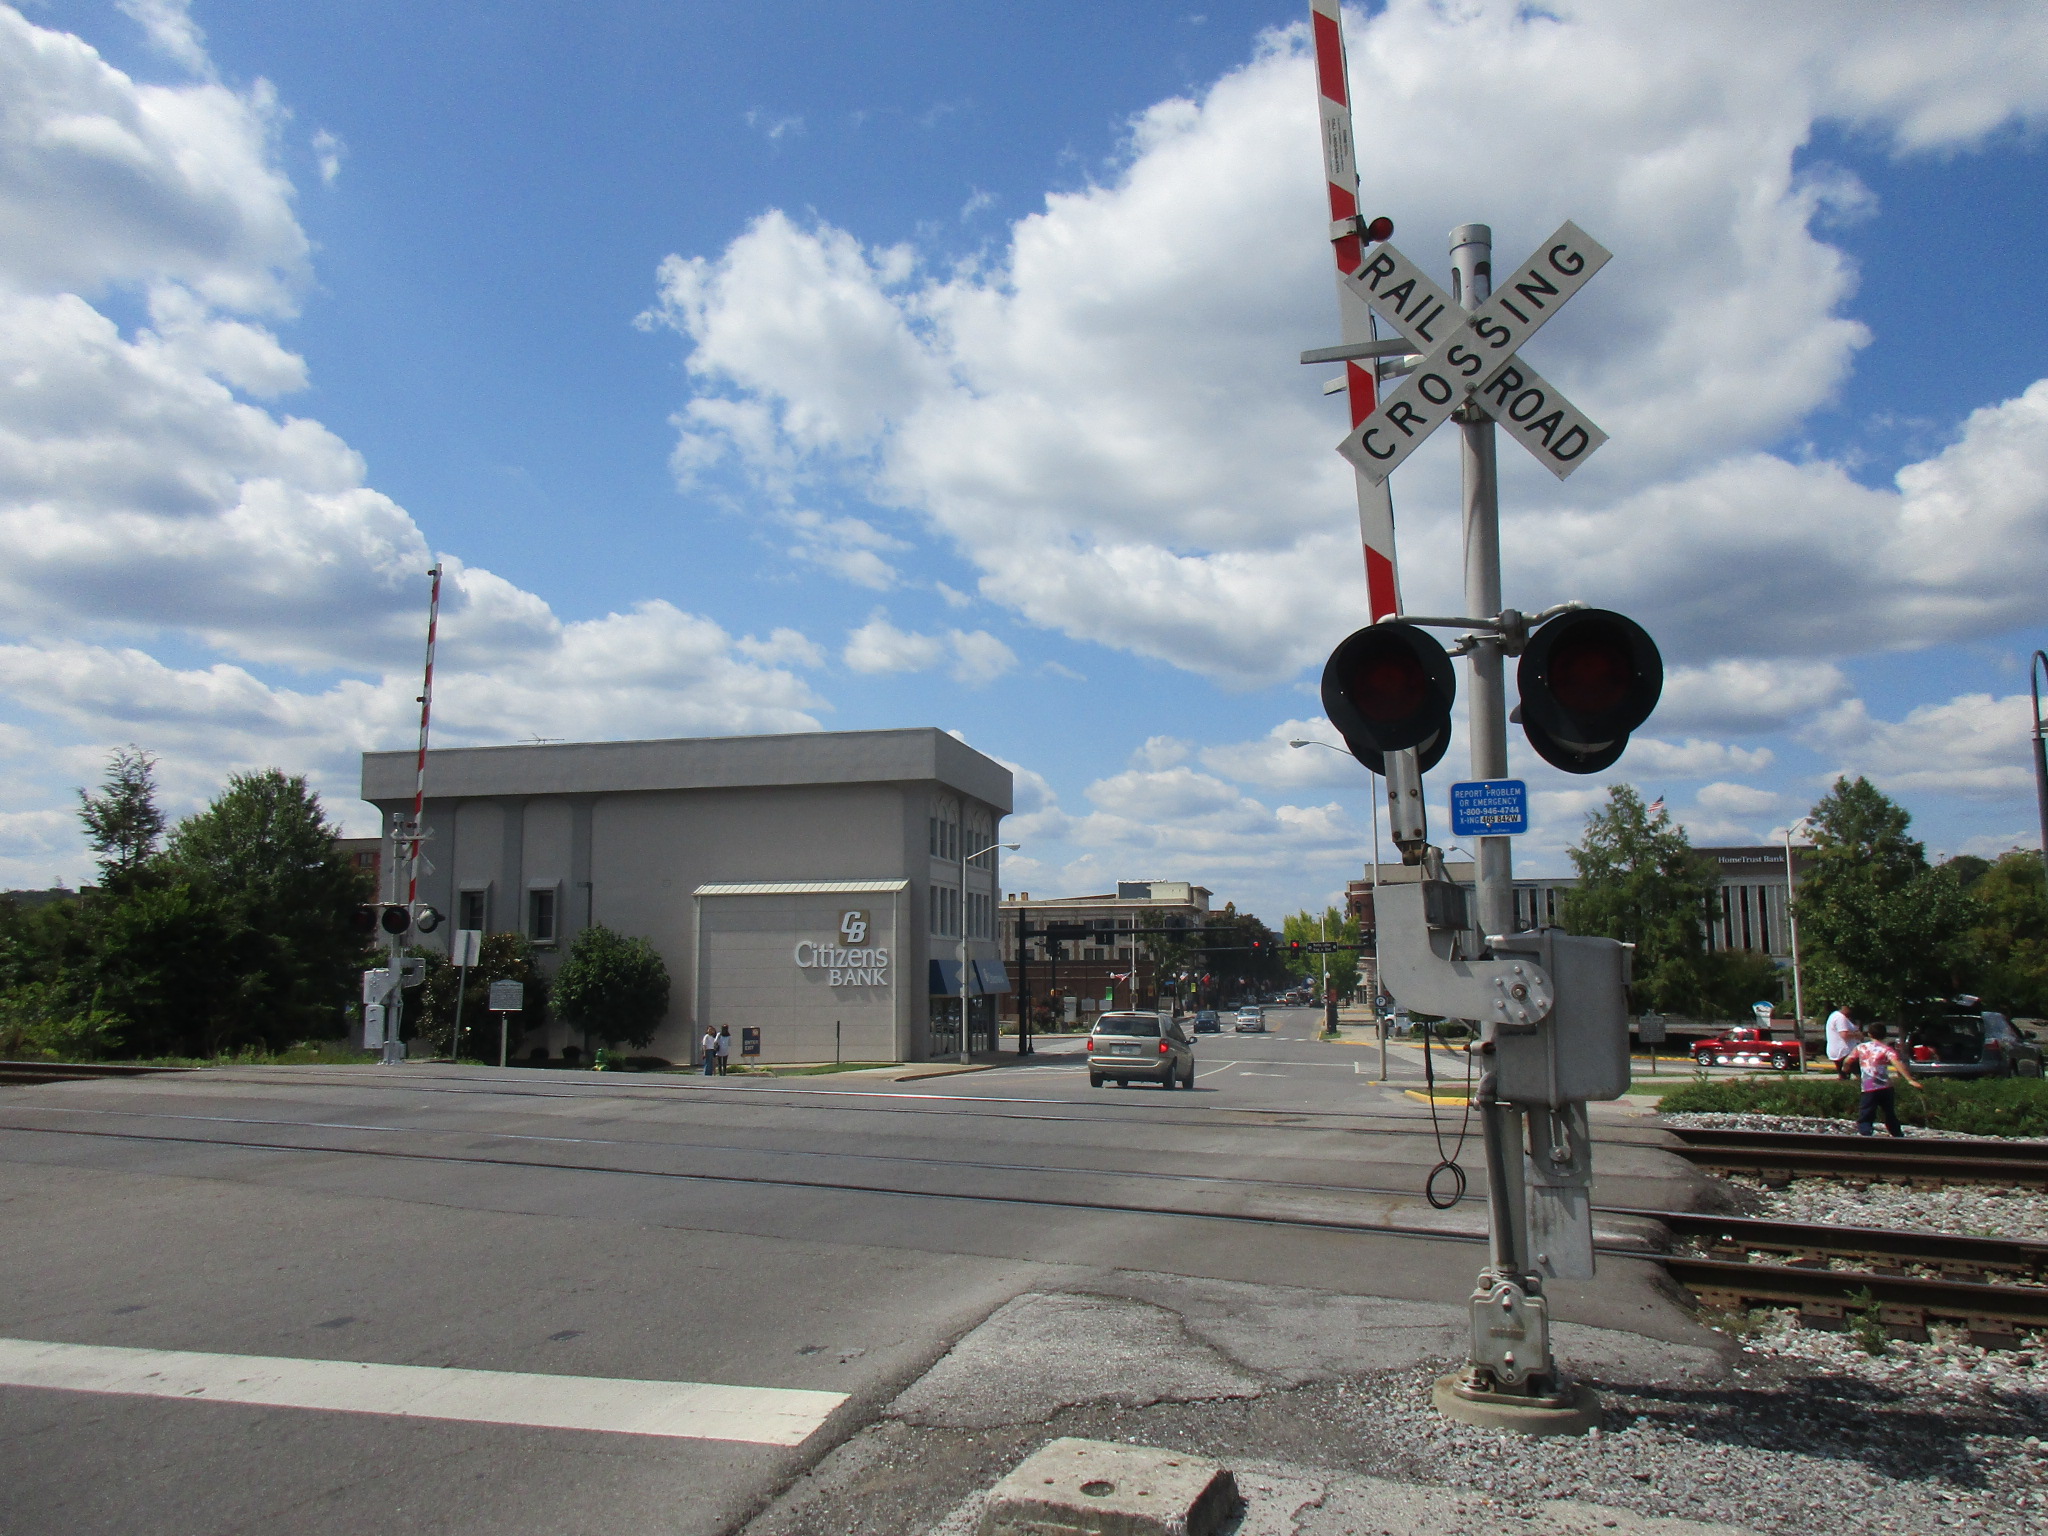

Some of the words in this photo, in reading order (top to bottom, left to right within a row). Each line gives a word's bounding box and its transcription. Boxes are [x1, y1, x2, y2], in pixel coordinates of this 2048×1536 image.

[1358, 253, 1445, 343] RAIL
[1484, 366, 1589, 462] ROAD
[1362, 244, 1585, 460] CROSSING
[1455, 789, 1483, 798] REPORT
[1487, 788, 1521, 797] PROBLEM
[1459, 799, 1470, 807] OR
[1473, 797, 1517, 806] EMERGENCY
[1459, 807, 1520, 815] 1-800-946-4744
[1459, 816, 1480, 824] X-ING
[1718, 856, 1762, 864] HomeTrust
[1763, 855, 1785, 863] Bank
[841, 911, 867, 943] CB
[794, 940, 888, 968] Citizens
[829, 968, 889, 986] BANK
